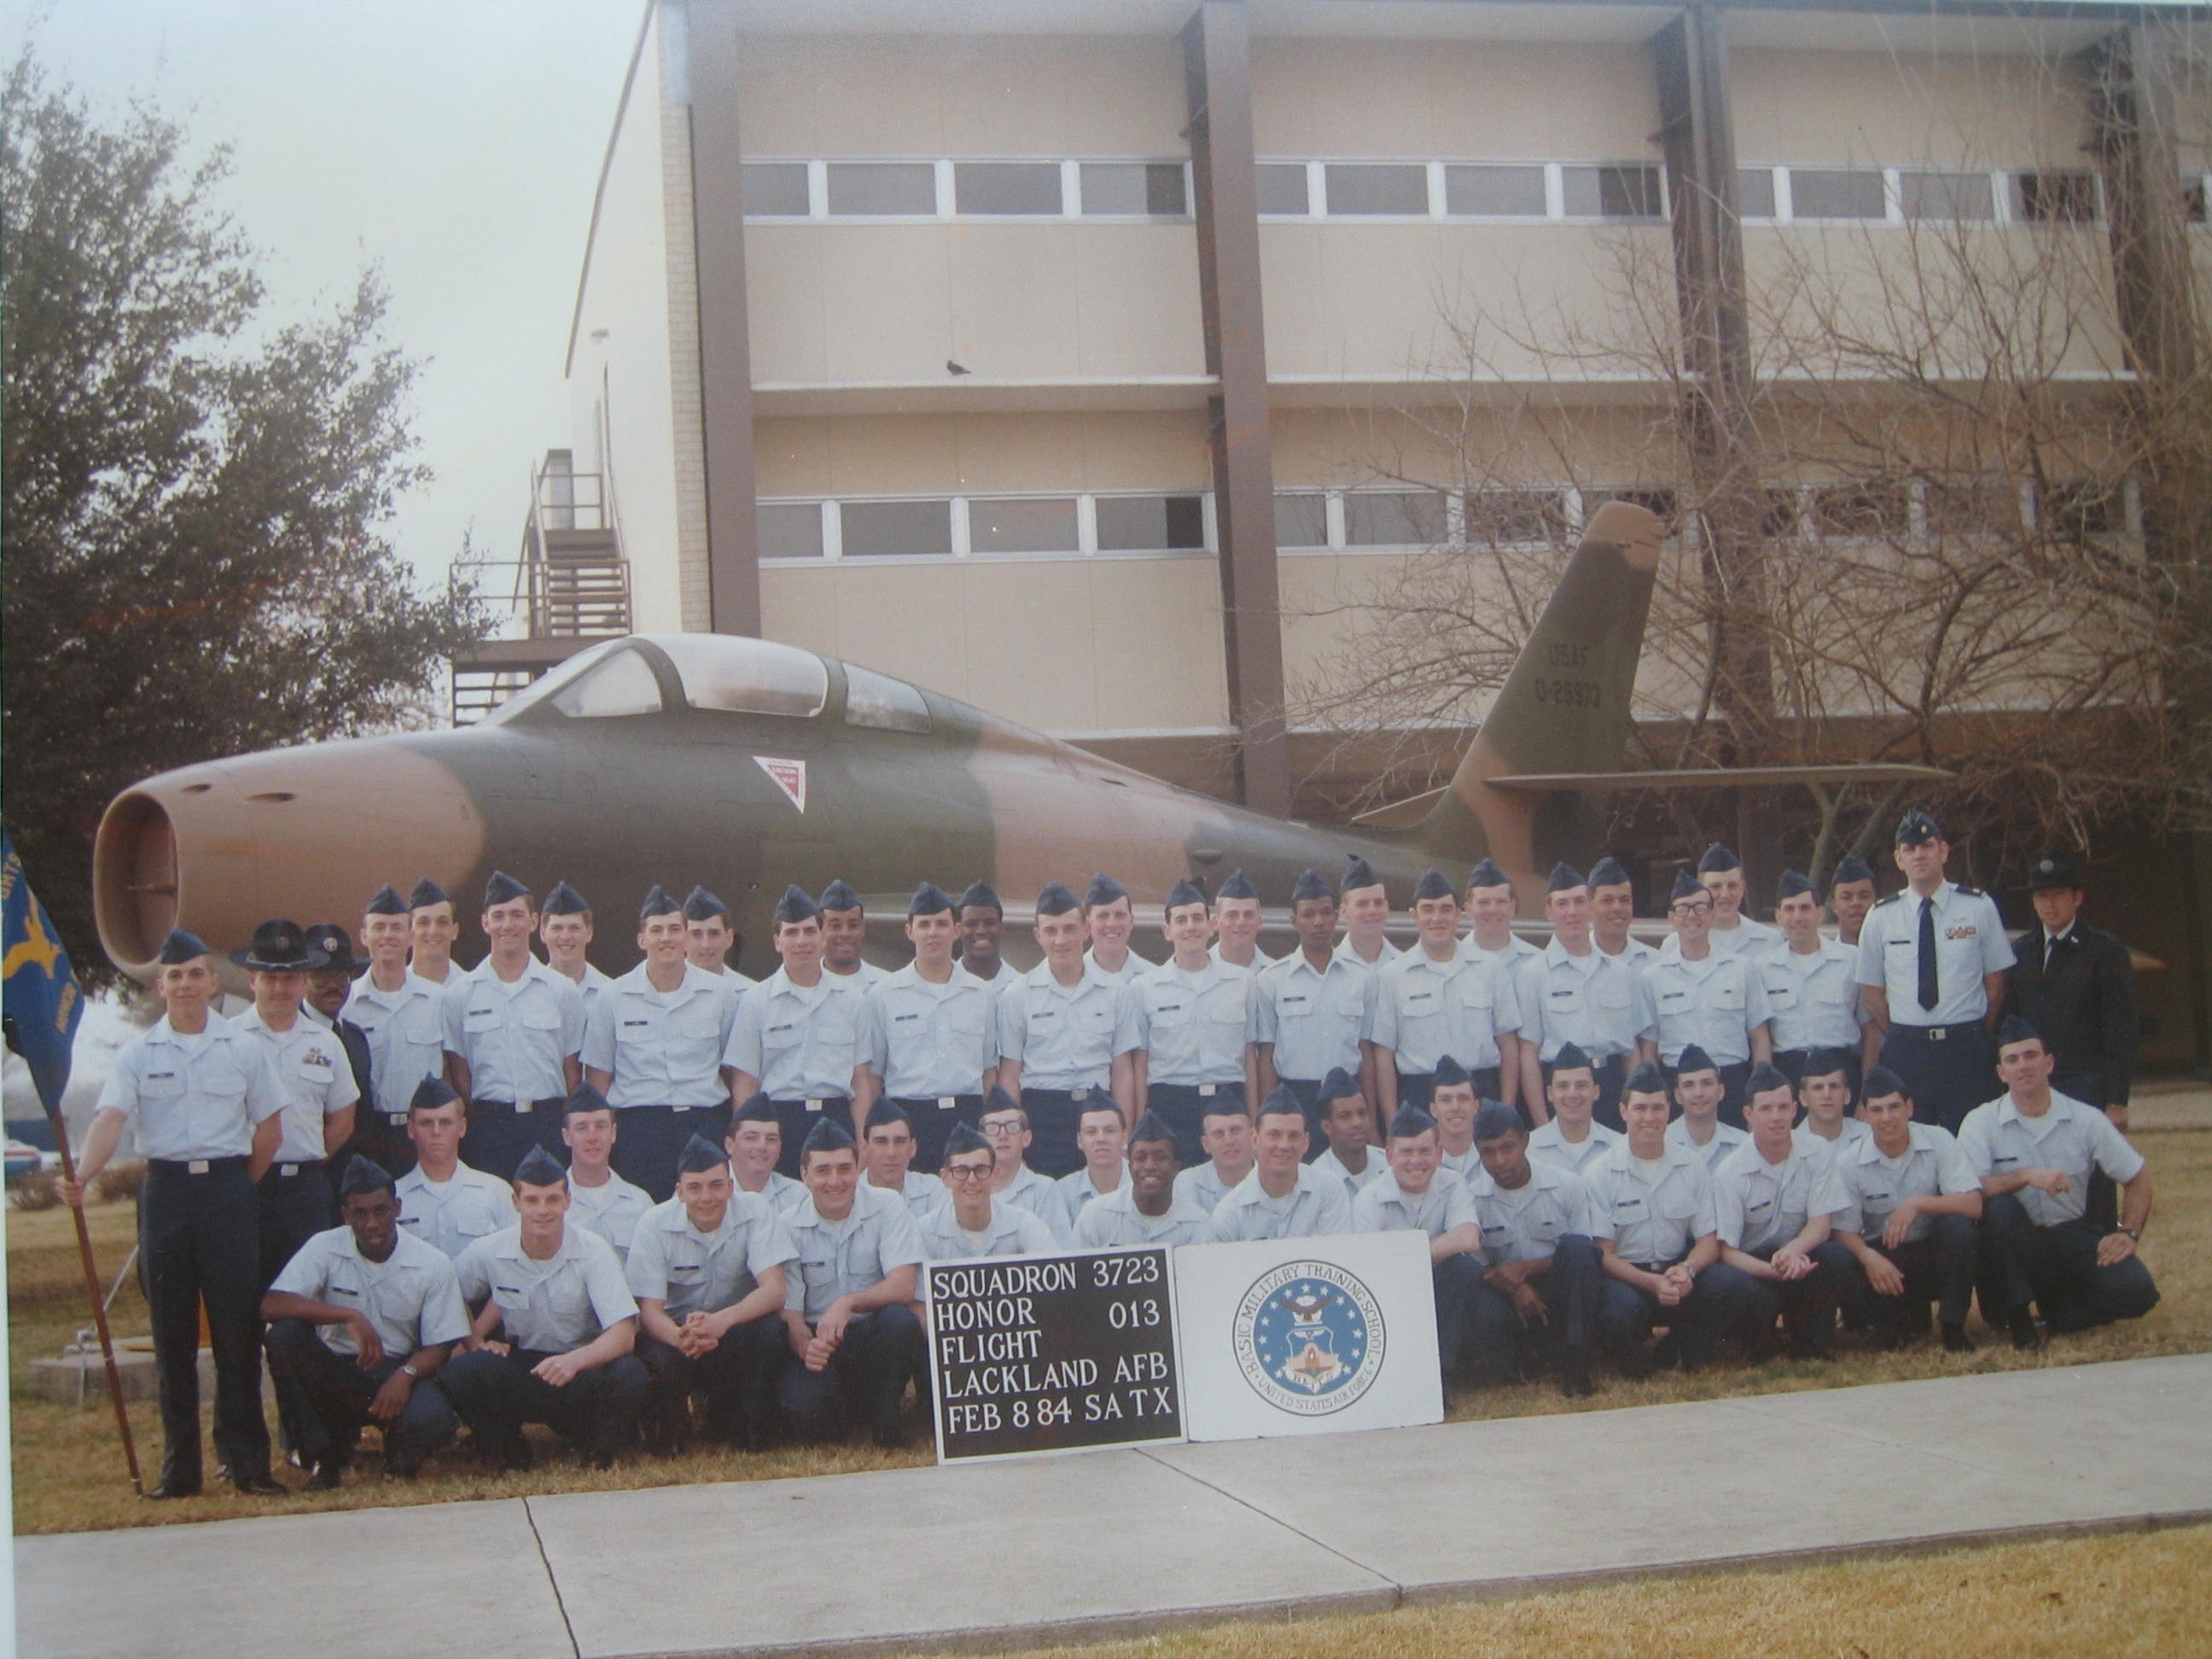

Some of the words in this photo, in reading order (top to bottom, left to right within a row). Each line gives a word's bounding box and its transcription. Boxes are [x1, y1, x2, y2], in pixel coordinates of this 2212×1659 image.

[1547, 642, 1589, 668] USAF
[933, 1262, 1077, 1300] SQUADRON
[1093, 1256, 1160, 1288] 3723
[1242, 1266, 1300, 1319] MILITARY
[1306, 1264, 1365, 1303] TRAINING
[936, 1297, 1036, 1331] HONOR
[1109, 1300, 1161, 1329] 013
[1361, 1301, 1381, 1359] SCHOOL
[942, 1330, 1042, 1365] FLIGHT
[1237, 1324, 1258, 1375] BASIC
[944, 1359, 1097, 1399] LACKLAND
[1114, 1352, 1168, 1383] AFB
[1257, 1377, 1294, 1408] UNITED
[1295, 1398, 1333, 1410] STATES
[1333, 1390, 1351, 1407] AIR
[1349, 1367, 1373, 1395] FORCE
[948, 1404, 1002, 1434] FEB
[1085, 1393, 1123, 1421] SA
[1129, 1387, 1173, 1417] TX
